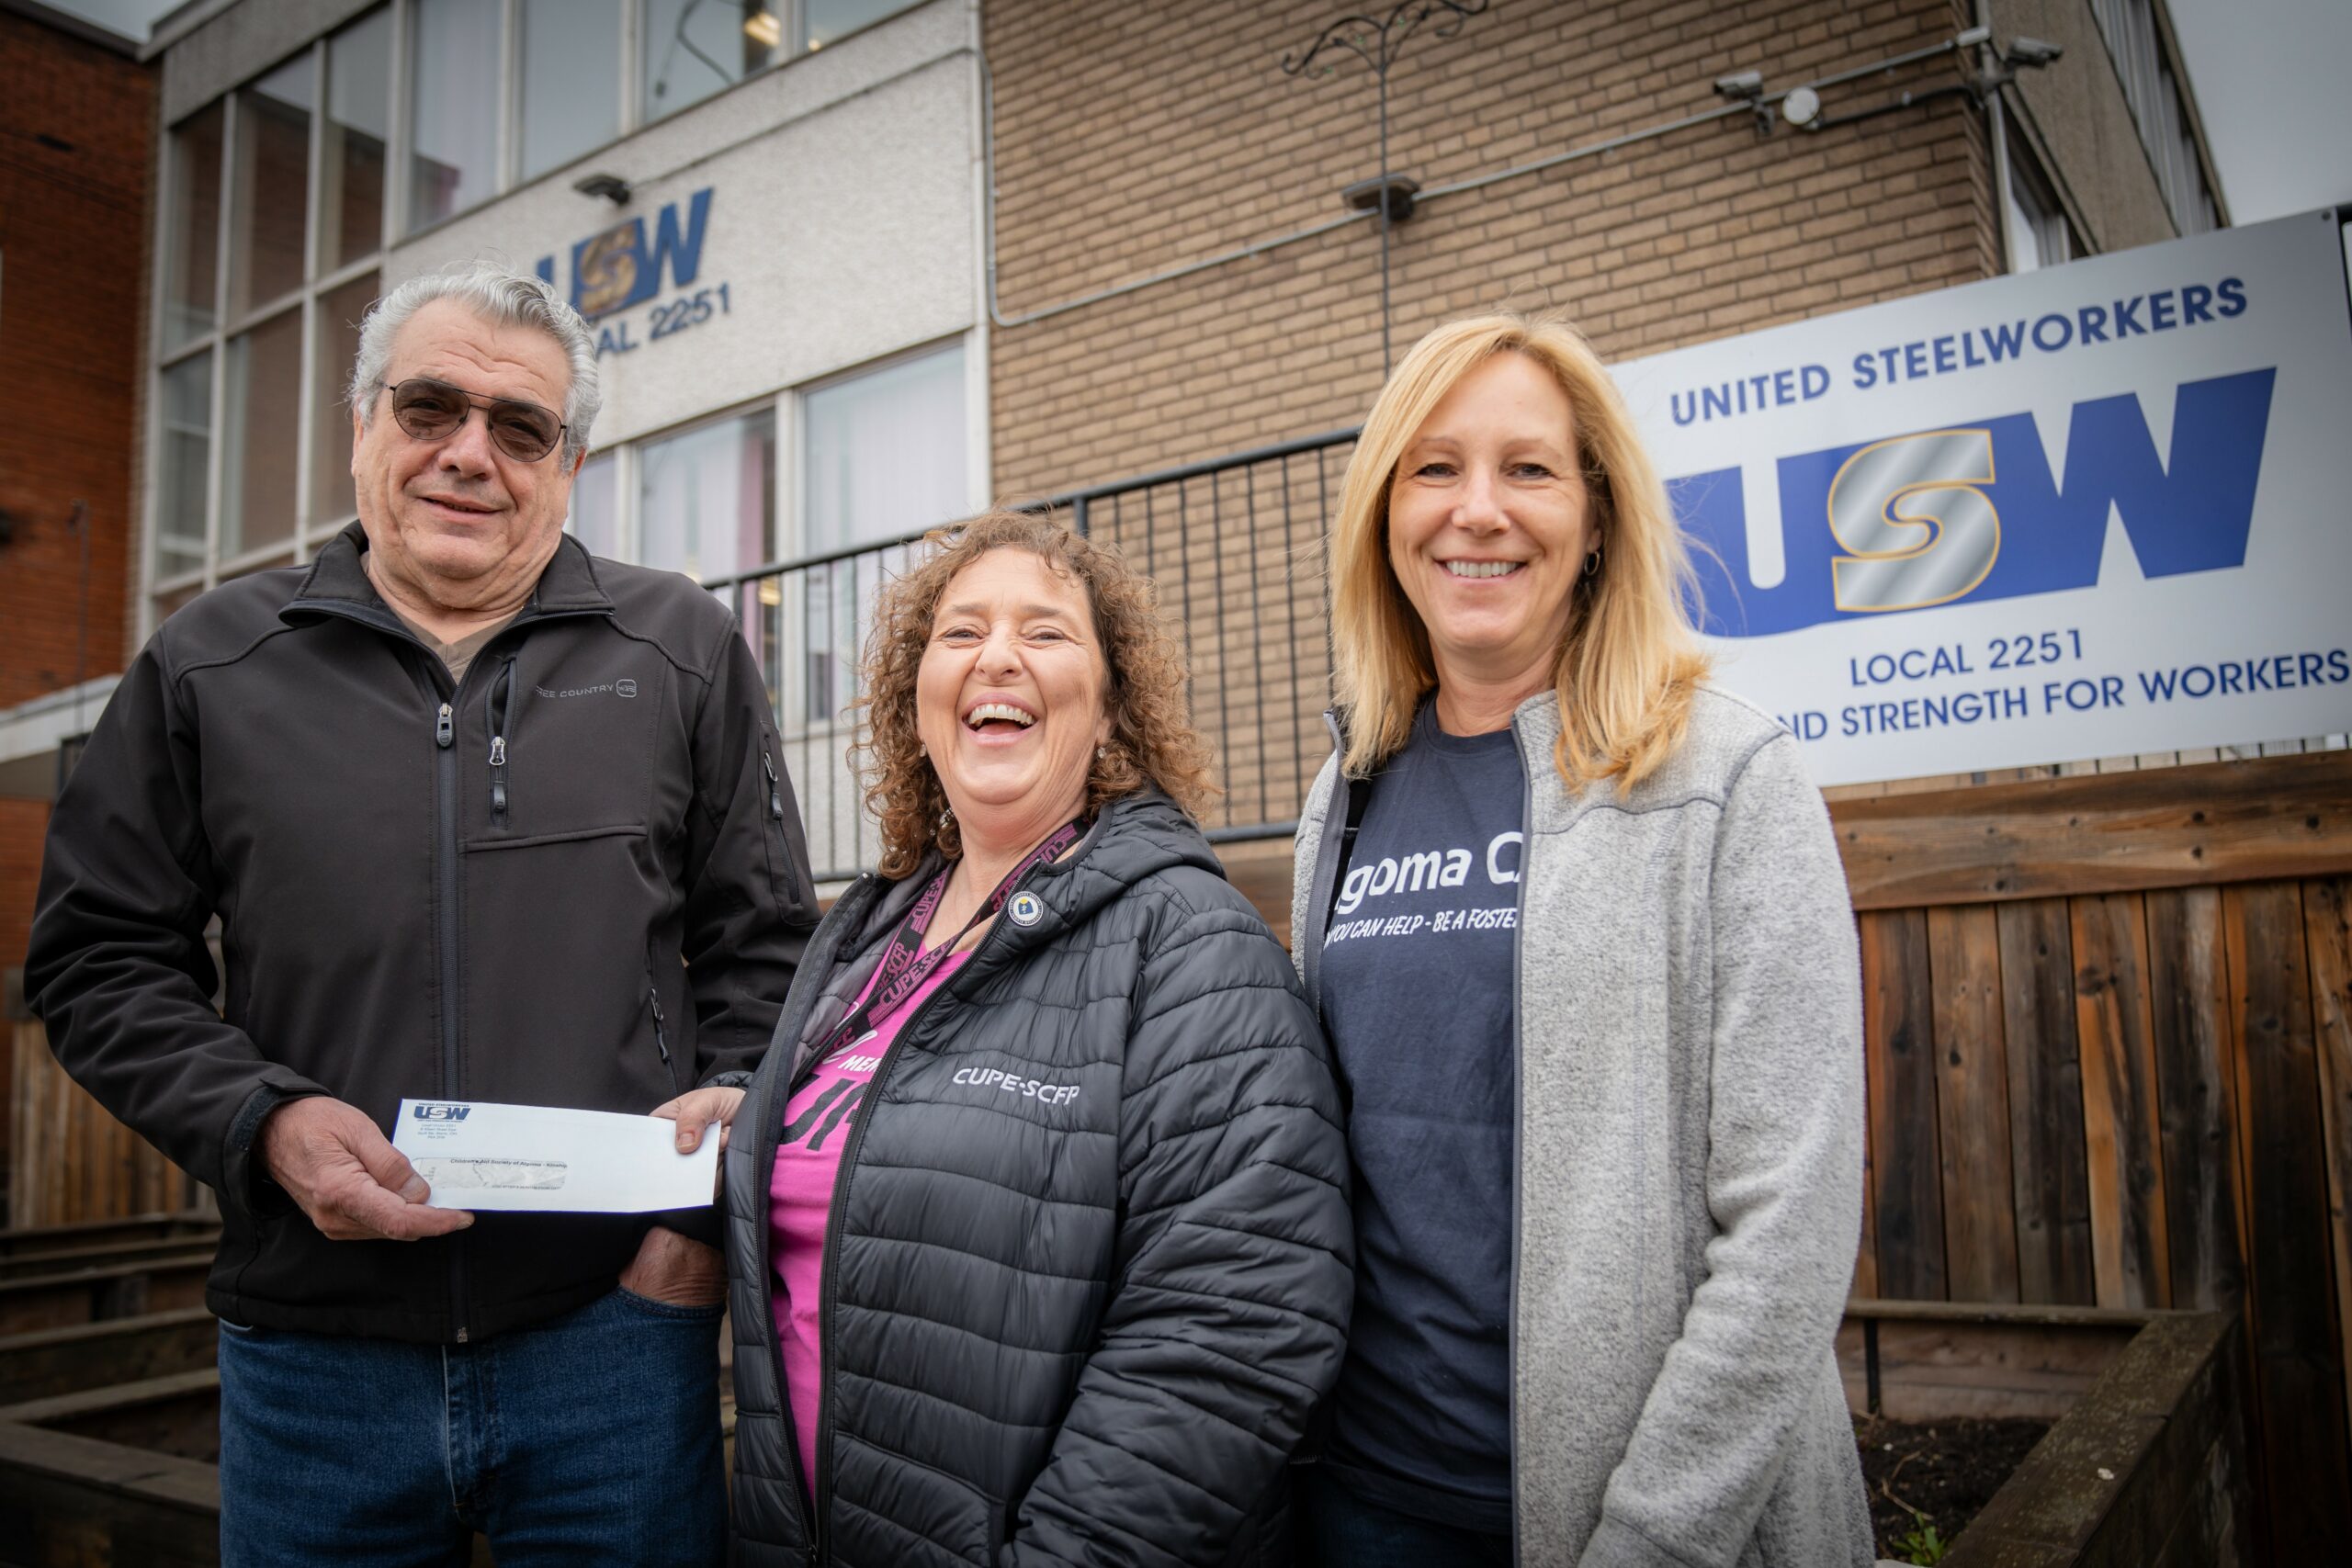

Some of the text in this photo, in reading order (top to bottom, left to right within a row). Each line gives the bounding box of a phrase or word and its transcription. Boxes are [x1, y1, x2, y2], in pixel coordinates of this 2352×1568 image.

[650, 284, 729, 341] 2251
[1670, 276, 2248, 427] UNITED STEELWORKERS
[1663, 365, 2278, 640] USW
[1849, 628, 2082, 687] LOCAL 2251
[560, 684, 614, 698] COUNTRY
[1841, 687, 2029, 737] STRENGTH
[2043, 677, 2124, 714] FOR
[2138, 649, 2351, 704] WORKERS
[1335, 849, 1473, 915] goma
[1351, 918, 1385, 939] CAN
[1381, 915, 1424, 936] HELP
[1432, 910, 1454, 932] BE
[1452, 909, 1466, 931] A
[413, 1105, 471, 1121] USW
